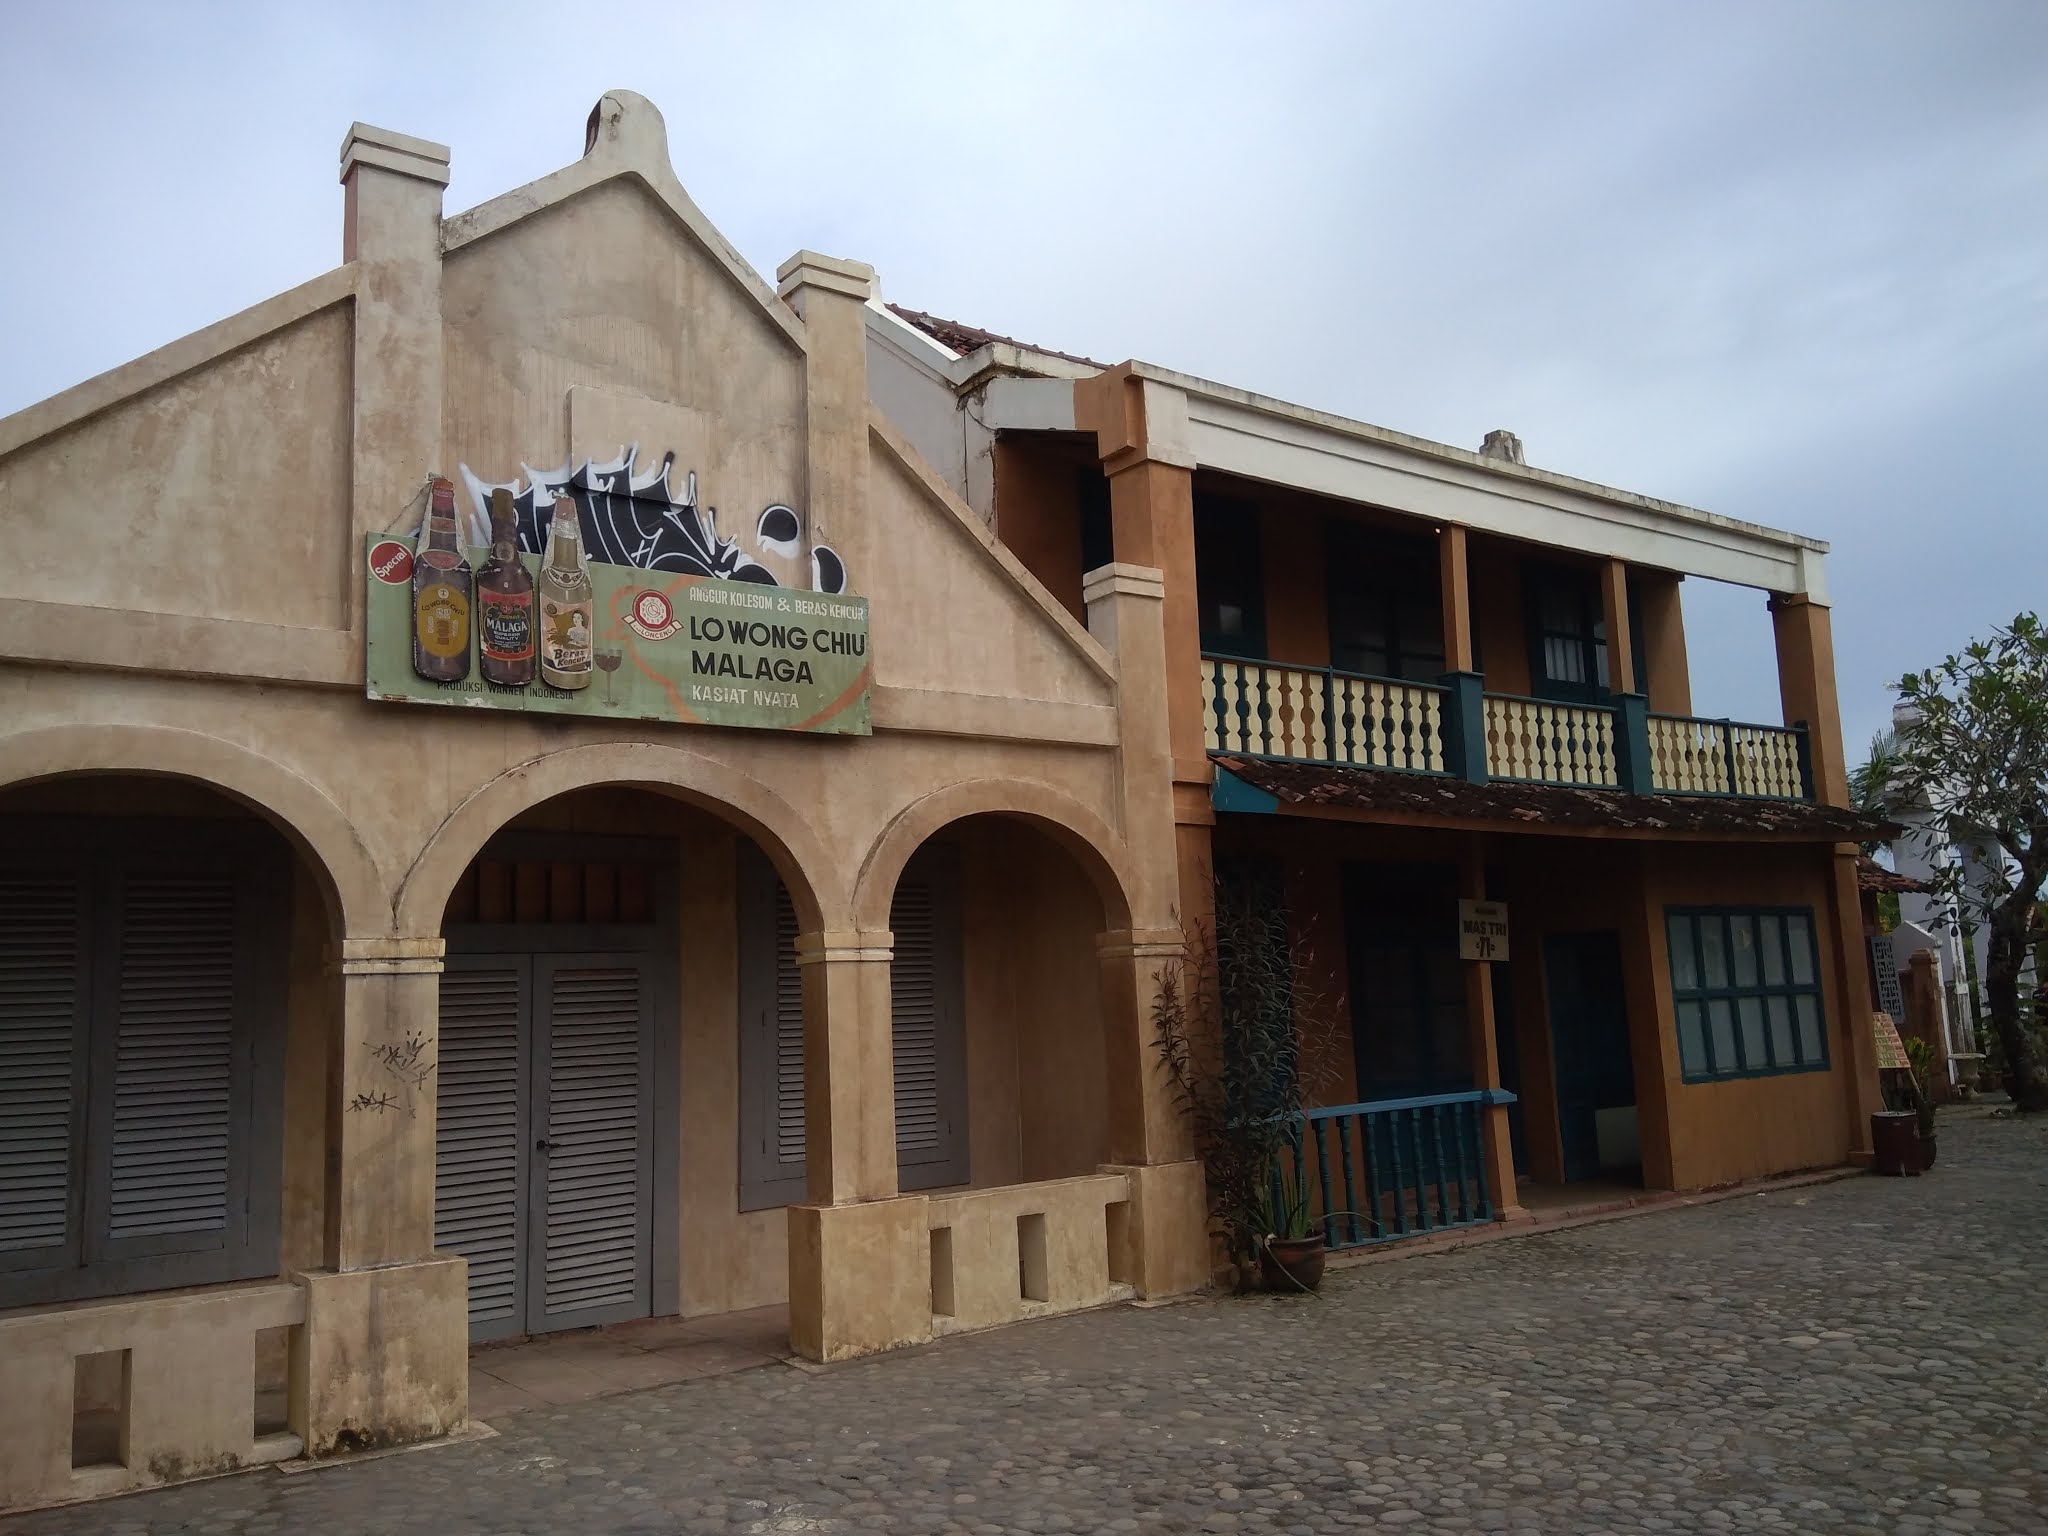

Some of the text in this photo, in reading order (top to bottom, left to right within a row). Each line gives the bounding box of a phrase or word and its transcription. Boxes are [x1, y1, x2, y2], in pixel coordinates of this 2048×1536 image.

[374, 546, 408, 579] Special
[689, 586, 864, 621] ANGGUR KOLESOM & BERAS KENCUR
[486, 617, 528, 633] MALAGA
[640, 628, 673, 639] LONCENG
[690, 616, 865, 656] LO WONG CHIU
[553, 648, 585, 661] Beras
[557, 655, 586, 667] Kencur
[691, 650, 814, 685] MALAGA
[529, 688, 574, 701] INDONESIA
[692, 685, 800, 709] KASIAT NYATA
